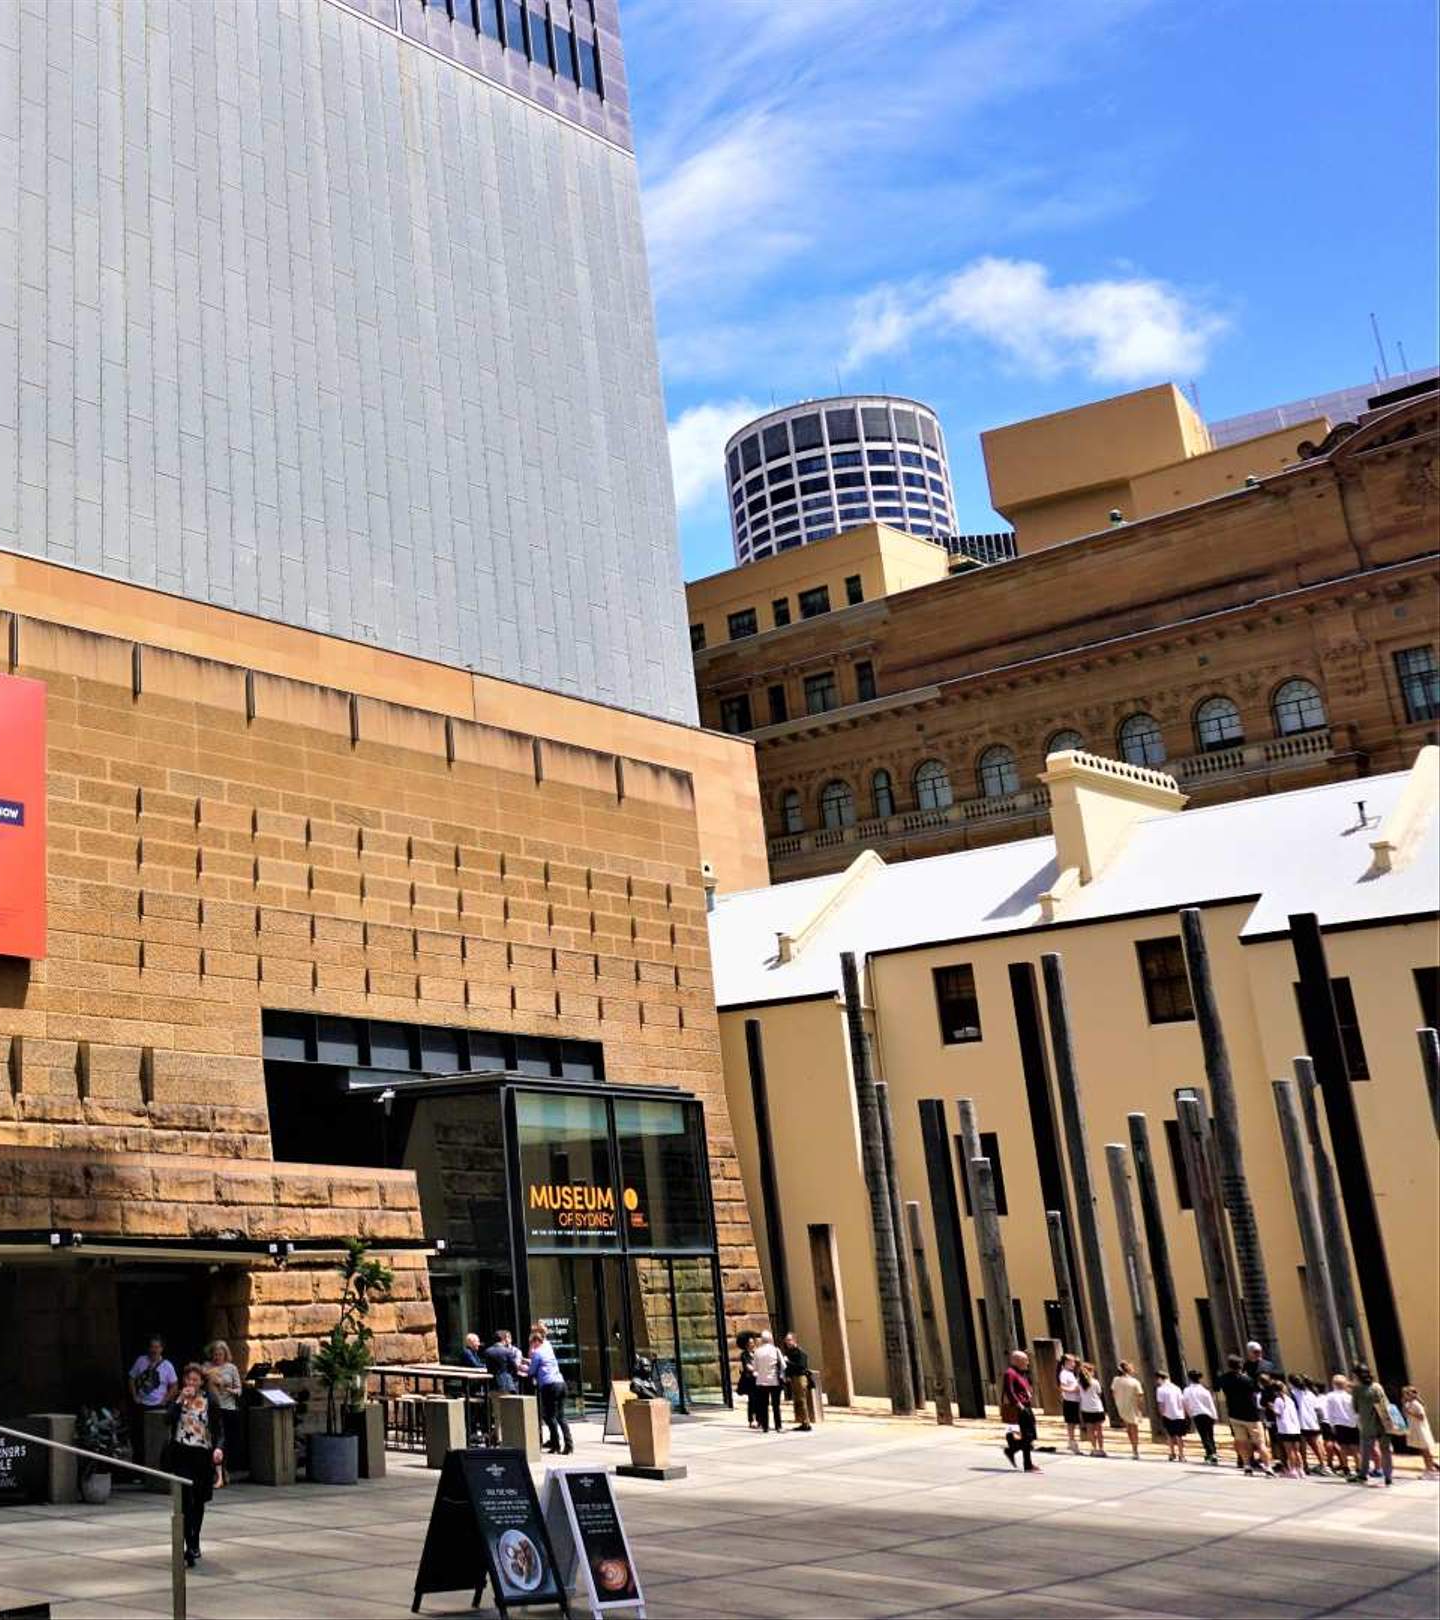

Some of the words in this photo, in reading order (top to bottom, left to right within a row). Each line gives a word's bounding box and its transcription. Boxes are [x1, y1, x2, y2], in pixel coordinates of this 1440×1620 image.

[529, 1184, 615, 1211] MUSEUM
[558, 1212, 574, 1226] OF
[575, 1212, 615, 1227] SYDNEY
